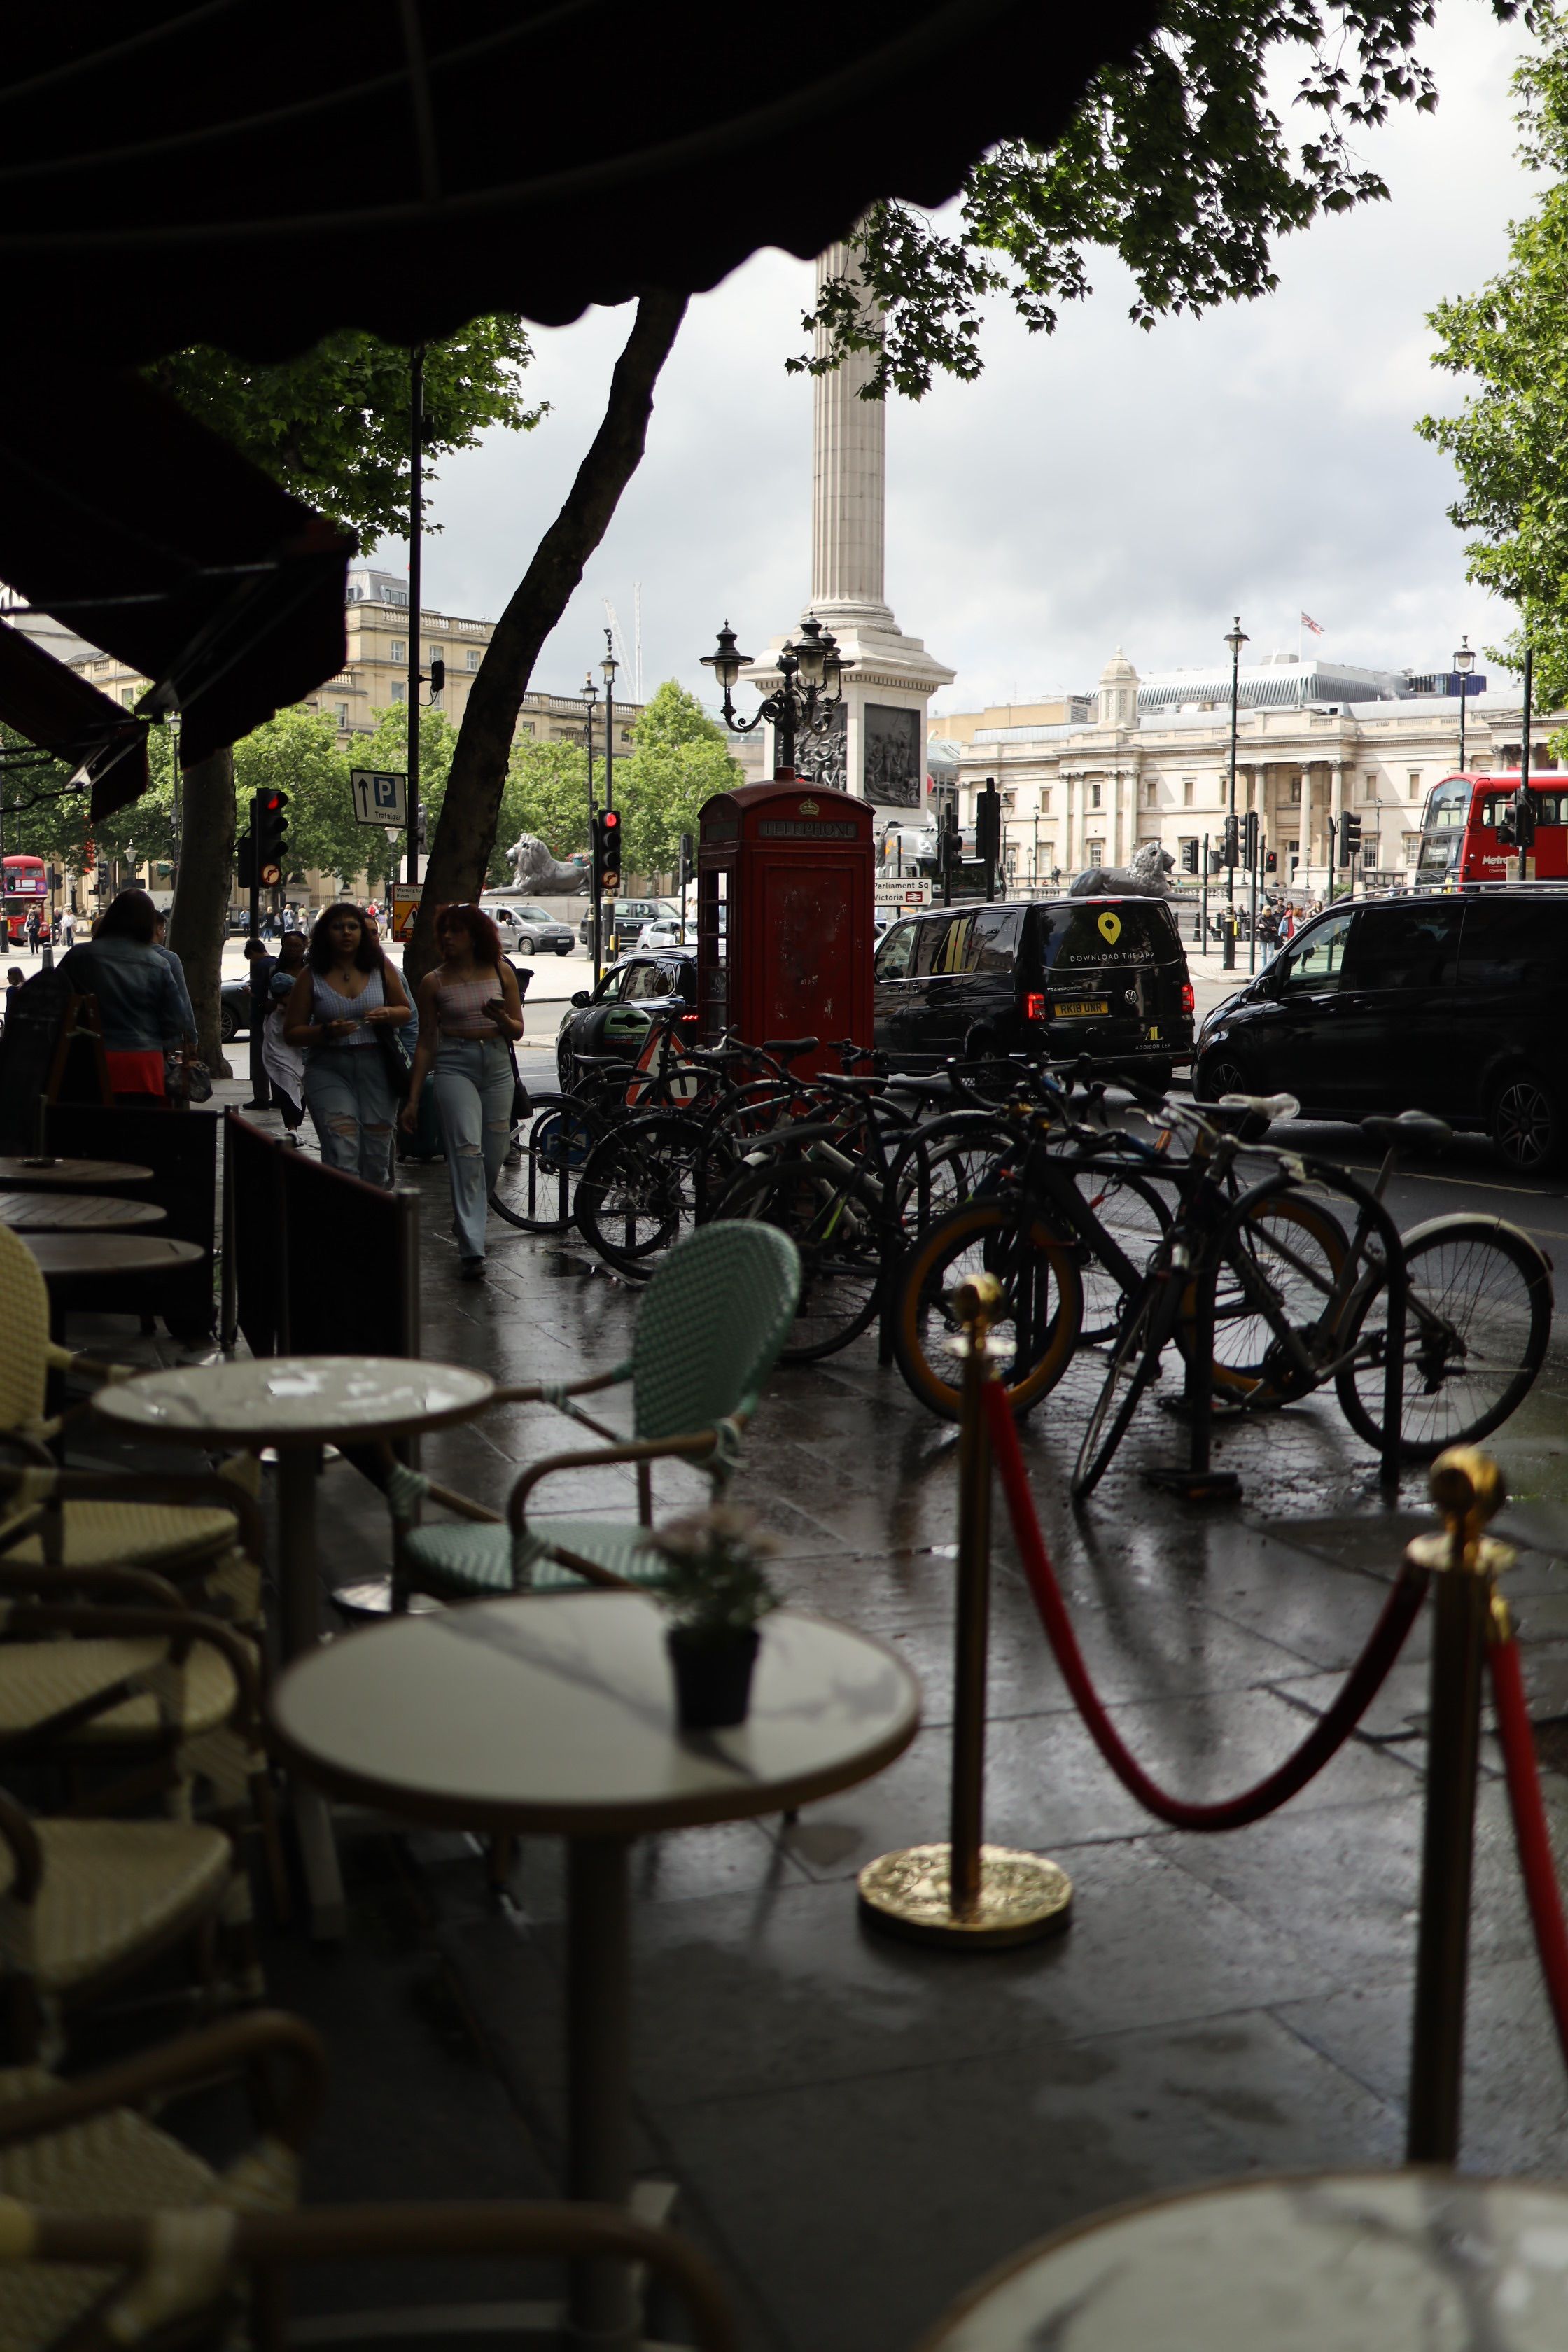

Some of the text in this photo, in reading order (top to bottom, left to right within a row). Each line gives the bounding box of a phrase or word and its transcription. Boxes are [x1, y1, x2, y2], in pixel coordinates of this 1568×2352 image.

[379, 780, 392, 804] P
[375, 811, 401, 822] Trafalgar
[765, 822, 855, 838] TELEPHONE
[918, 881, 929, 890] Sq
[1070, 953, 1119, 962] DOWNLOAD
[1060, 1002, 1102, 1014] RK18 UNR
